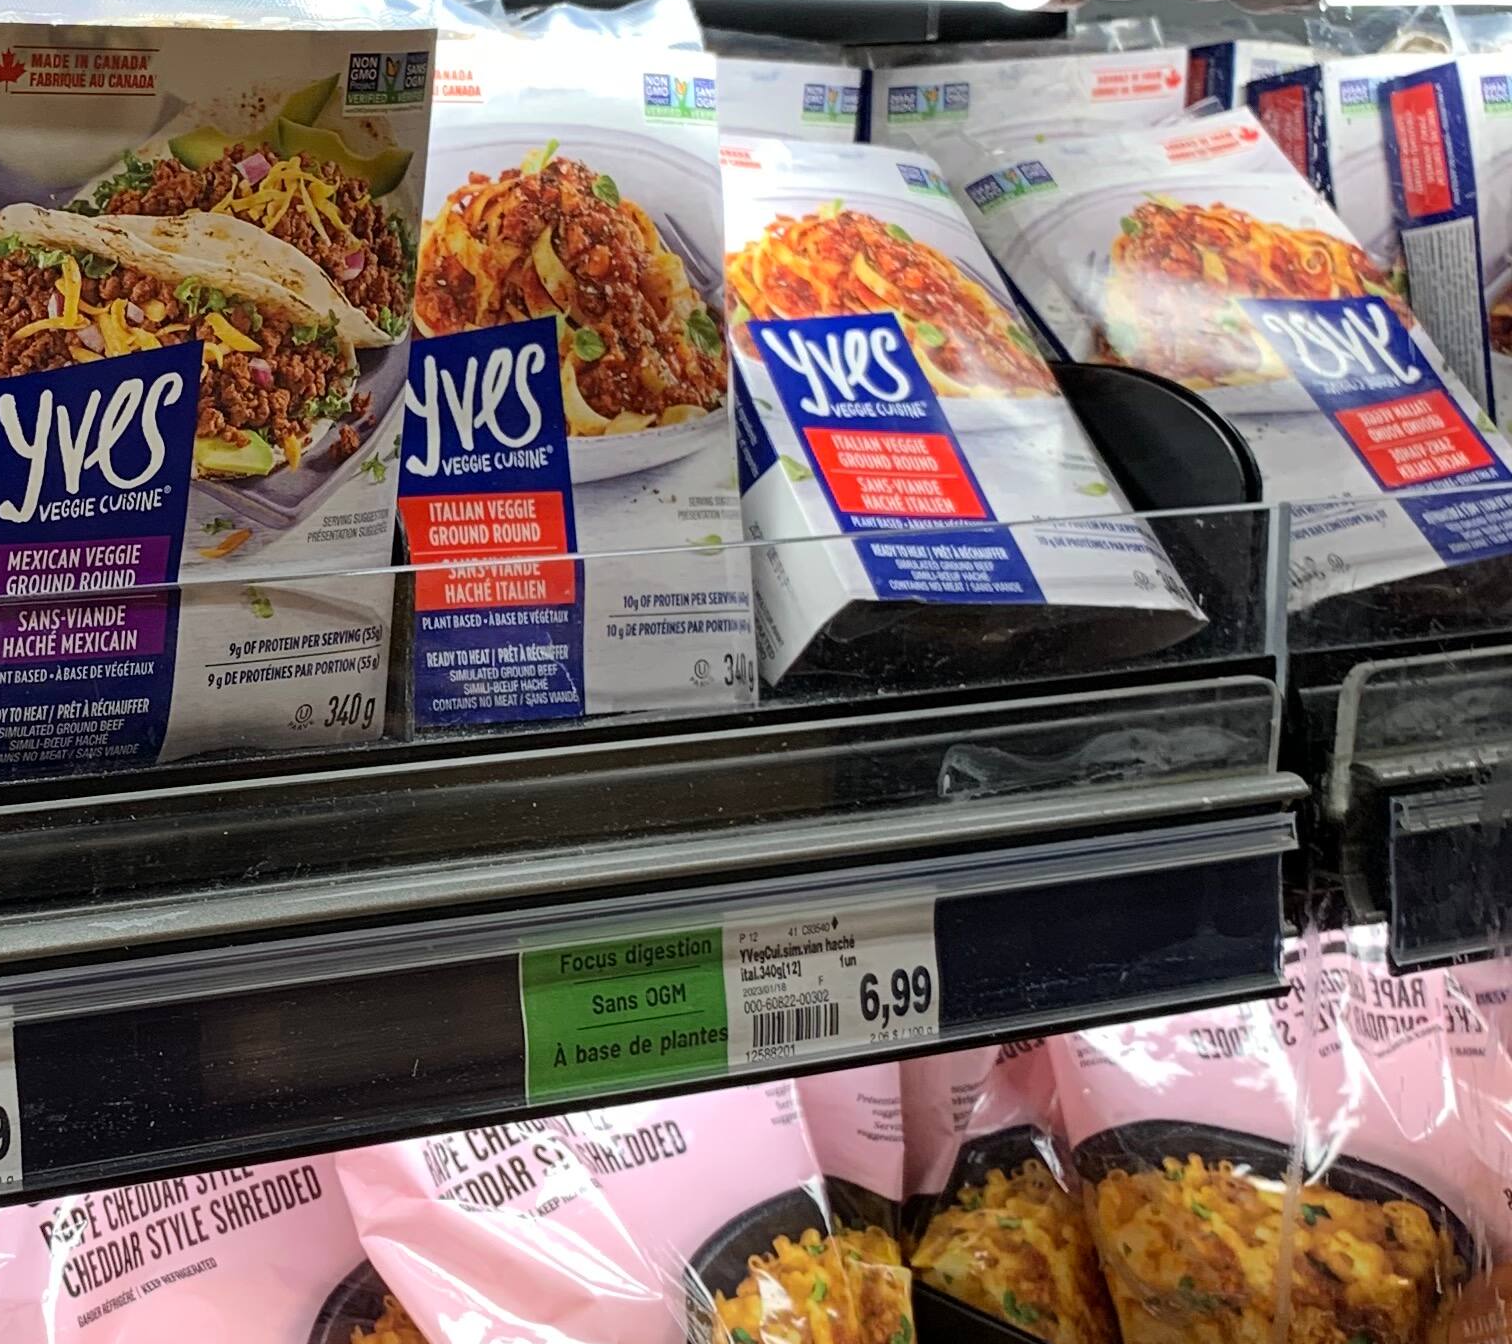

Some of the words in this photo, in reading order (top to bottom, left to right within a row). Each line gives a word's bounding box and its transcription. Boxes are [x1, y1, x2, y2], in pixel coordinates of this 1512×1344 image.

[428, 499, 484, 522] ITALIAN
[488, 498, 536, 520] VEGGIE
[7, 549, 80, 572] MEXICAN
[85, 543, 141, 568] VEGGIE
[324, 692, 361, 729] 340
[362, 696, 376, 730] g
[560, 952, 617, 975] Focus
[626, 936, 712, 968] digestion
[591, 993, 638, 1016] Sans
[645, 983, 687, 1007] OGM
[859, 964, 933, 1029] 6,99
[62, 1233, 144, 1299] CHEDDAR
[147, 1207, 205, 1261] STYLE
[205, 1162, 324, 1238] SHREDDED
